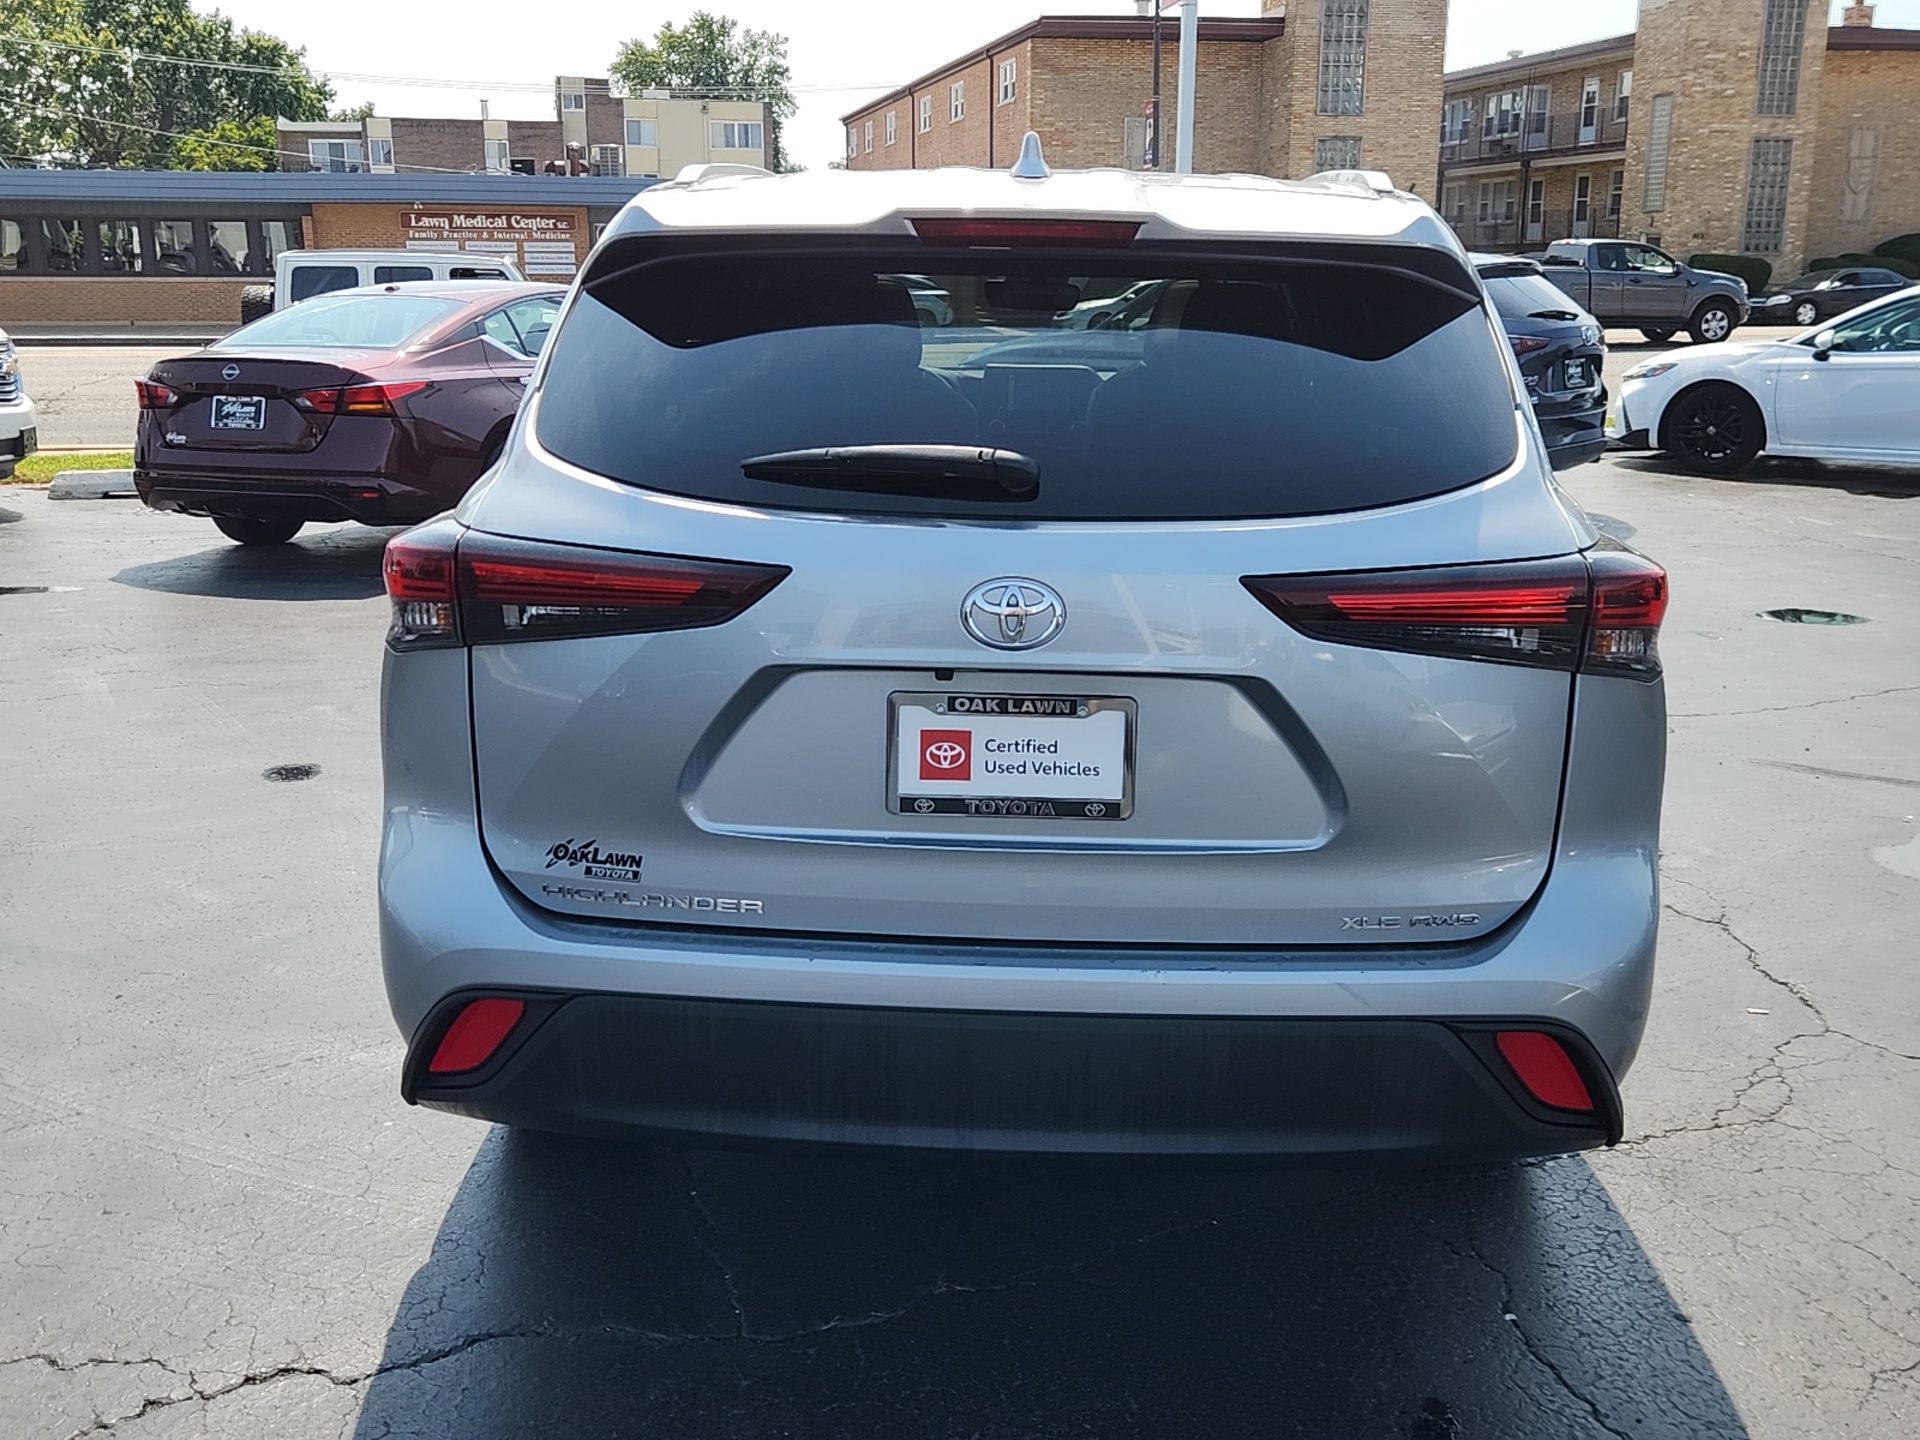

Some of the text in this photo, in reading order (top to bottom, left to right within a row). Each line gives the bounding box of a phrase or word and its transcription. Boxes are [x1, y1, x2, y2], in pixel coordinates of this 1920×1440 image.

[409, 214, 449, 230] Lawn
[452, 214, 508, 228] Medical
[511, 215, 556, 231] Center
[408, 230, 571, 240] Family Practice & Internal Medicine
[954, 697, 1071, 714] OAK LAWN
[984, 739, 1058, 754] Certified
[984, 759, 1101, 778] Used Vehicles
[965, 799, 1056, 817] TOYOTA
[591, 867, 634, 880] TOYOTA
[542, 884, 764, 915] HIGHLANDER
[1341, 916, 1401, 930] XLE
